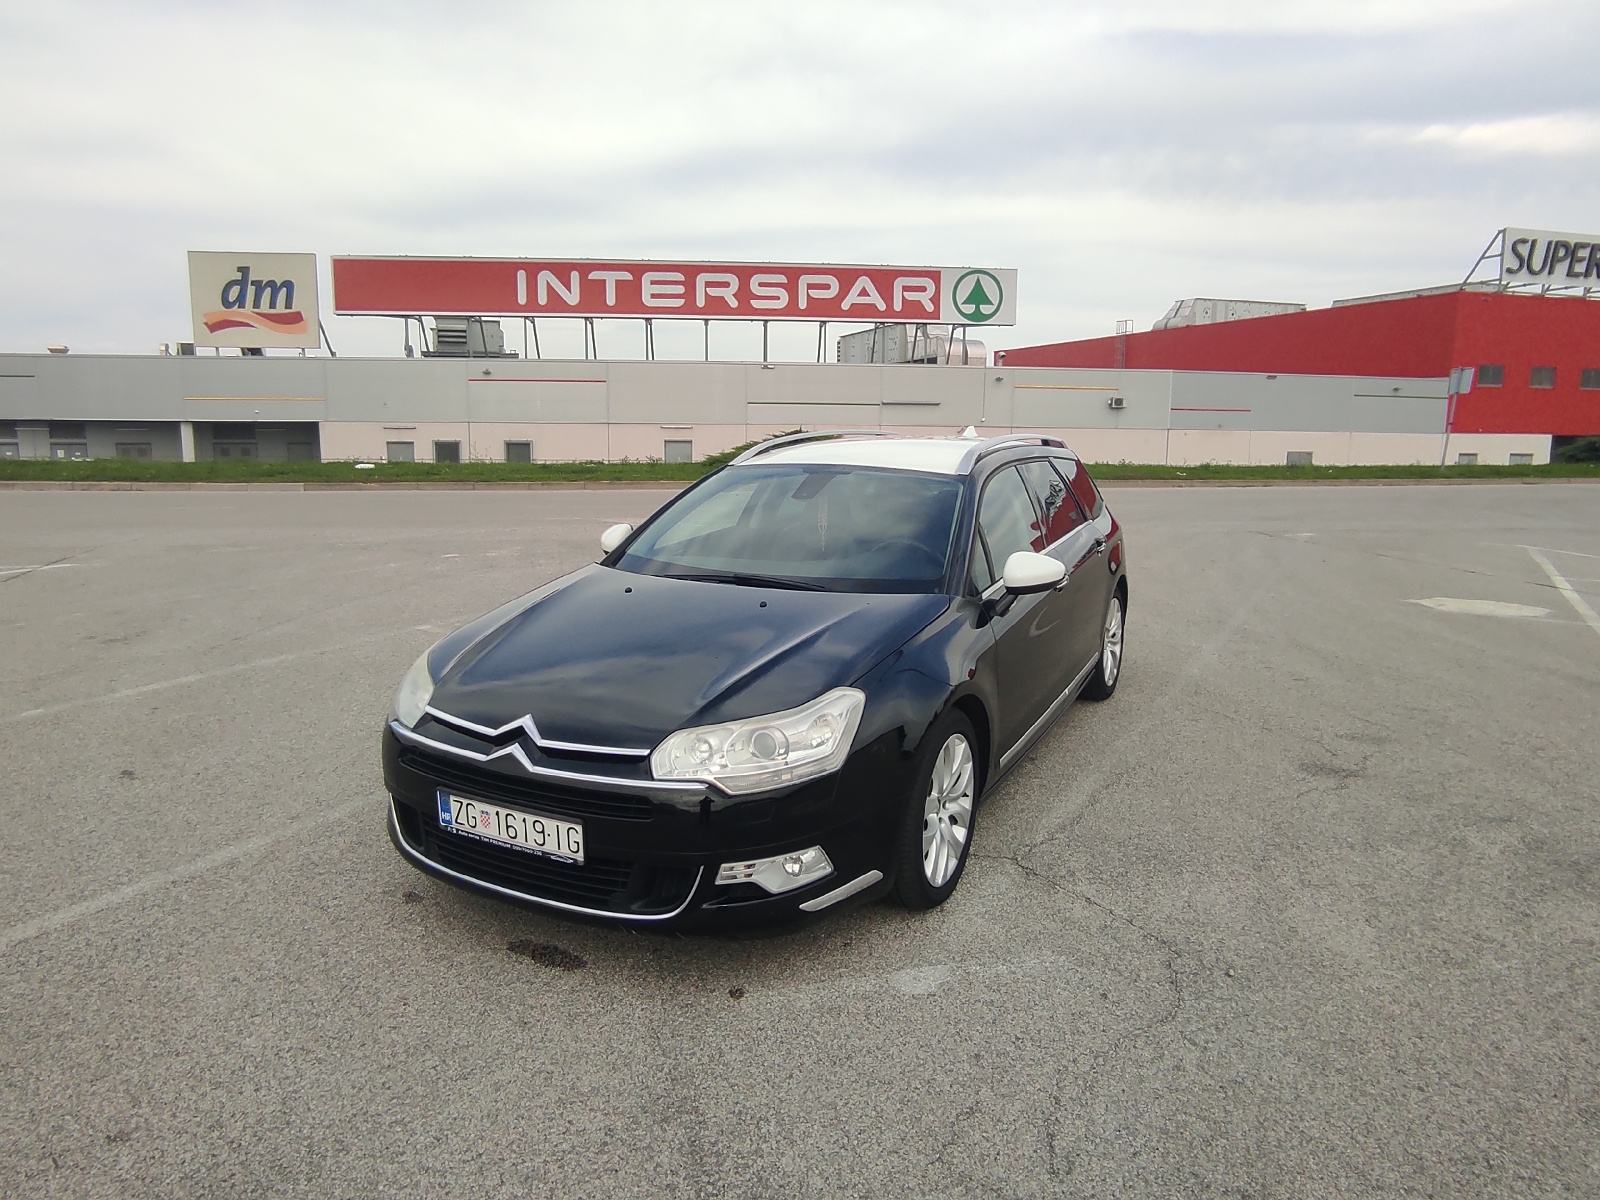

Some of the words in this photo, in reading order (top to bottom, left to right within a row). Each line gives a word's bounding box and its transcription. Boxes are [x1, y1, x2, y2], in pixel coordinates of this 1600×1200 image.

[1506, 237, 1600, 279] SUPER
[221, 266, 296, 310] dm
[517, 269, 937, 312] INTERSPAR
[453, 799, 477, 829] ZG
